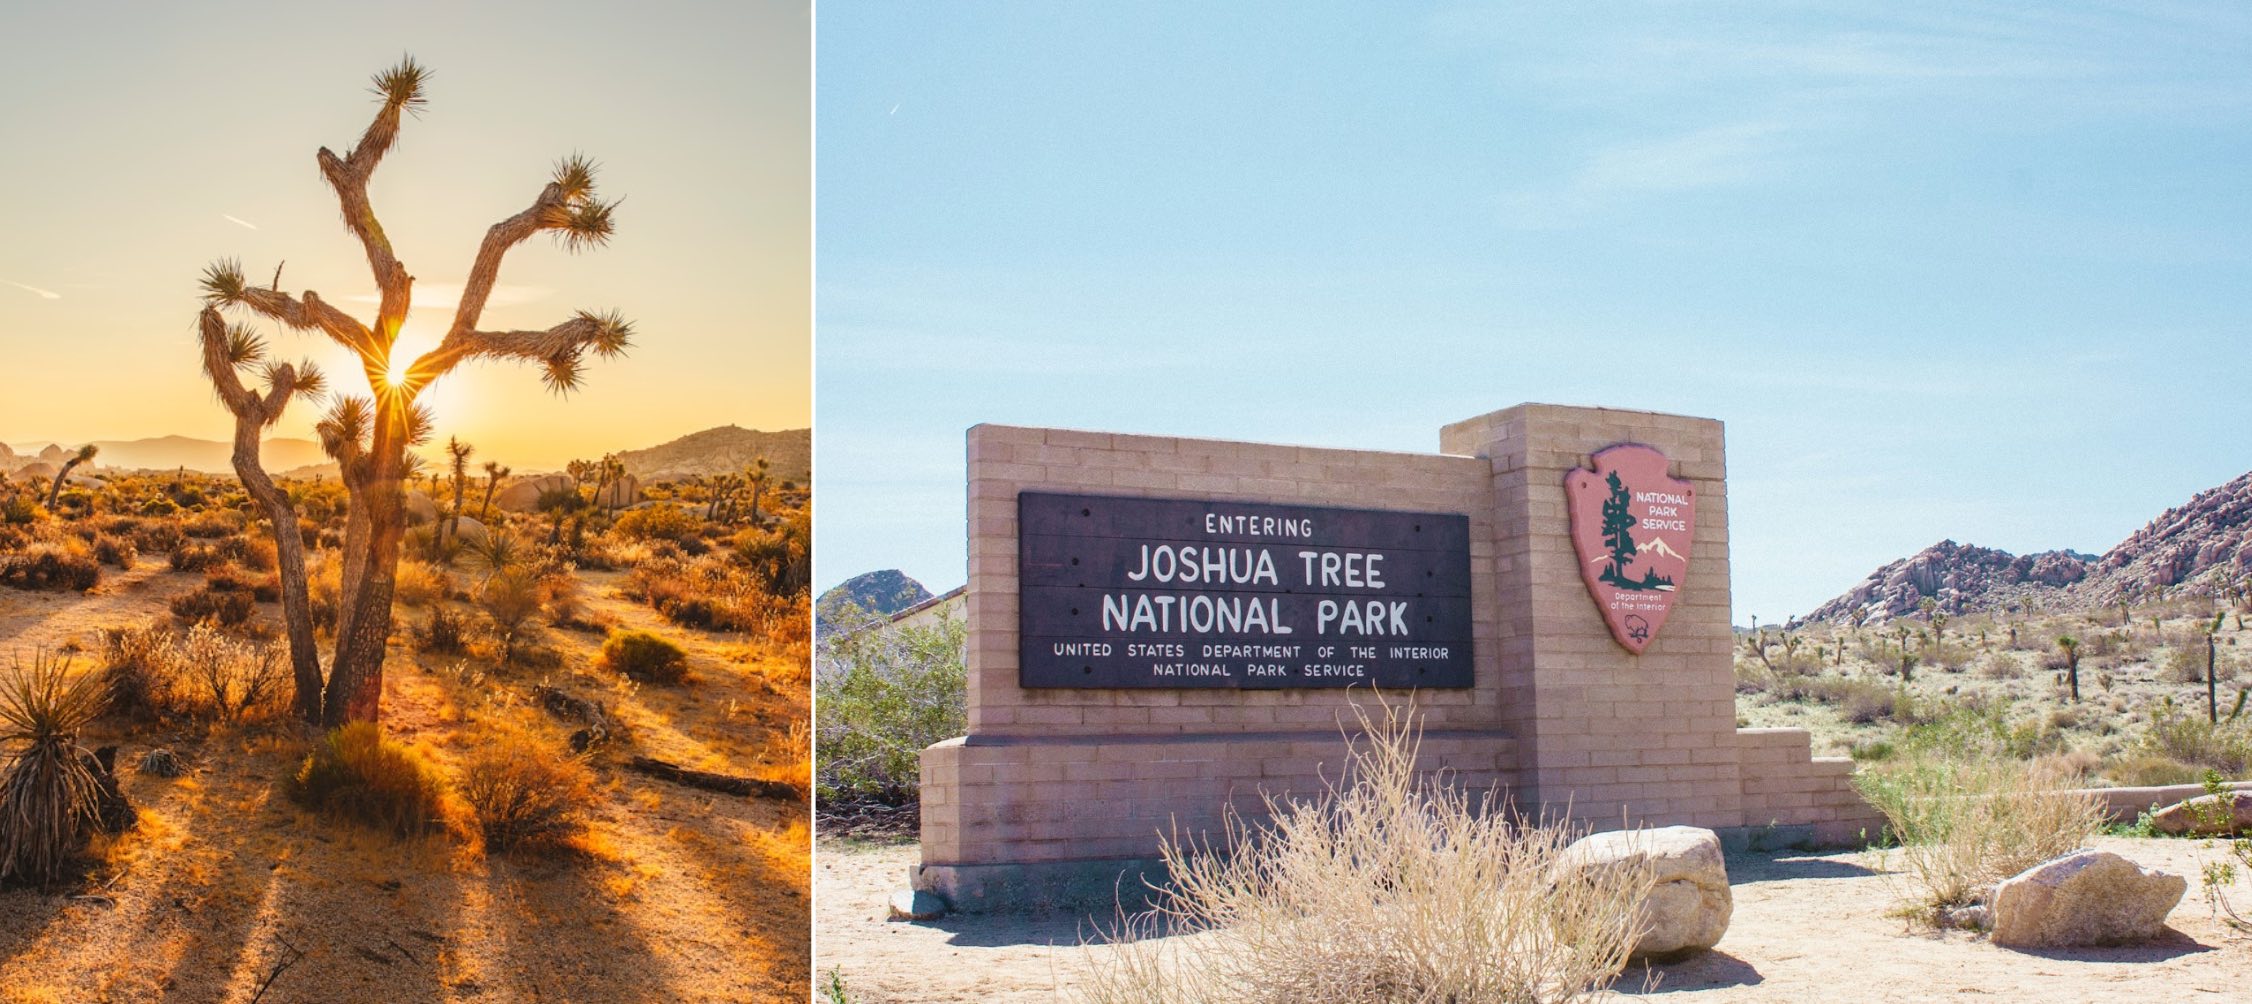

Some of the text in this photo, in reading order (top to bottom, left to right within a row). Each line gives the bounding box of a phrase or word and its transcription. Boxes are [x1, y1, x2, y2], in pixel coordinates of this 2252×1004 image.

[1636, 491, 1688, 505] NATIONAL
[1649, 505, 1677, 517] PARK
[1205, 513, 1312, 538] ENTERING
[1642, 518, 1686, 531] SERVICE
[1128, 544, 1386, 589] JOSHUA TREE
[1615, 592, 1661, 602] Department
[1610, 601, 1619, 610] of
[1621, 601, 1634, 611] the
[1102, 593, 1409, 636] NATIONAL PARK
[1053, 642, 1449, 660] UNITED STATES DEPARTMENT OF THE INTERIOR
[1153, 663, 1365, 678] NATIONAL PARK SERVICE
